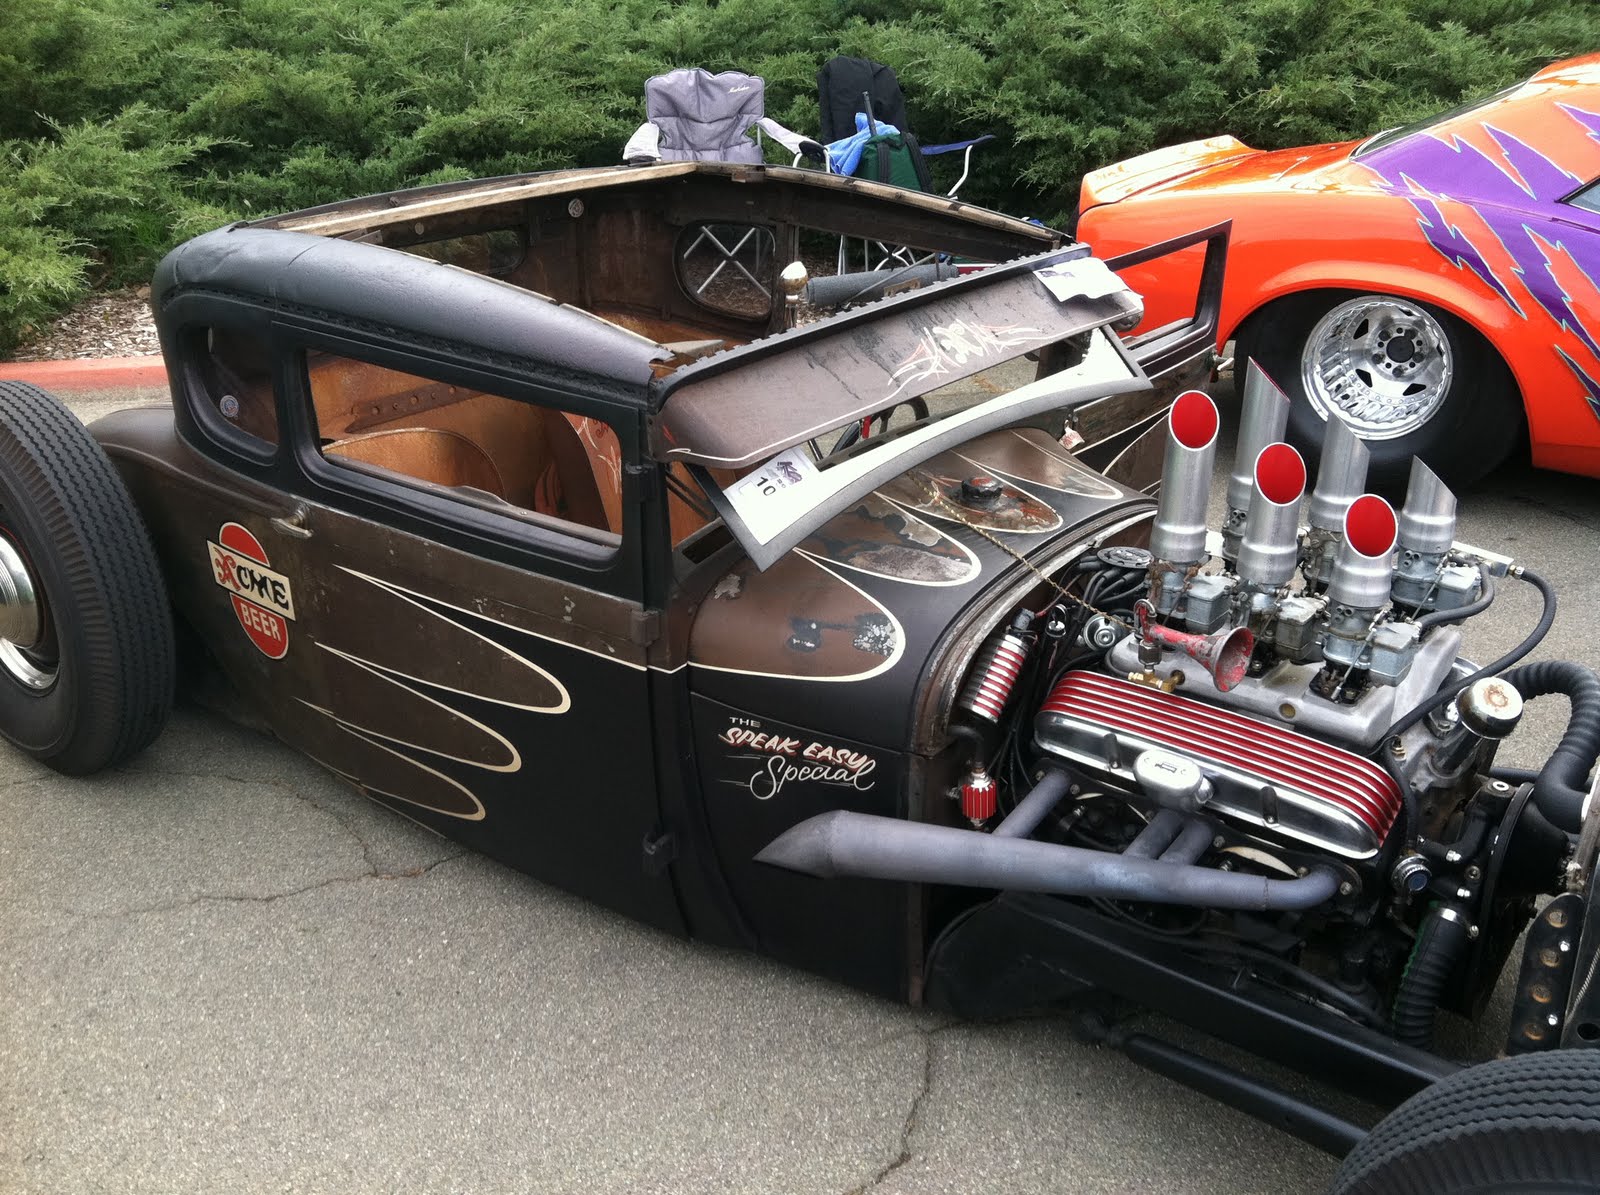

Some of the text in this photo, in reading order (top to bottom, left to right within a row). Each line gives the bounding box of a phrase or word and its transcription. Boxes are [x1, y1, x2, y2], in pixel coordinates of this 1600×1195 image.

[213, 547, 289, 610] ACME
[240, 602, 281, 641] BEER
[729, 717, 761, 728] THE
[718, 727, 868, 771] SPEAK EASY
[750, 755, 876, 800] Special
